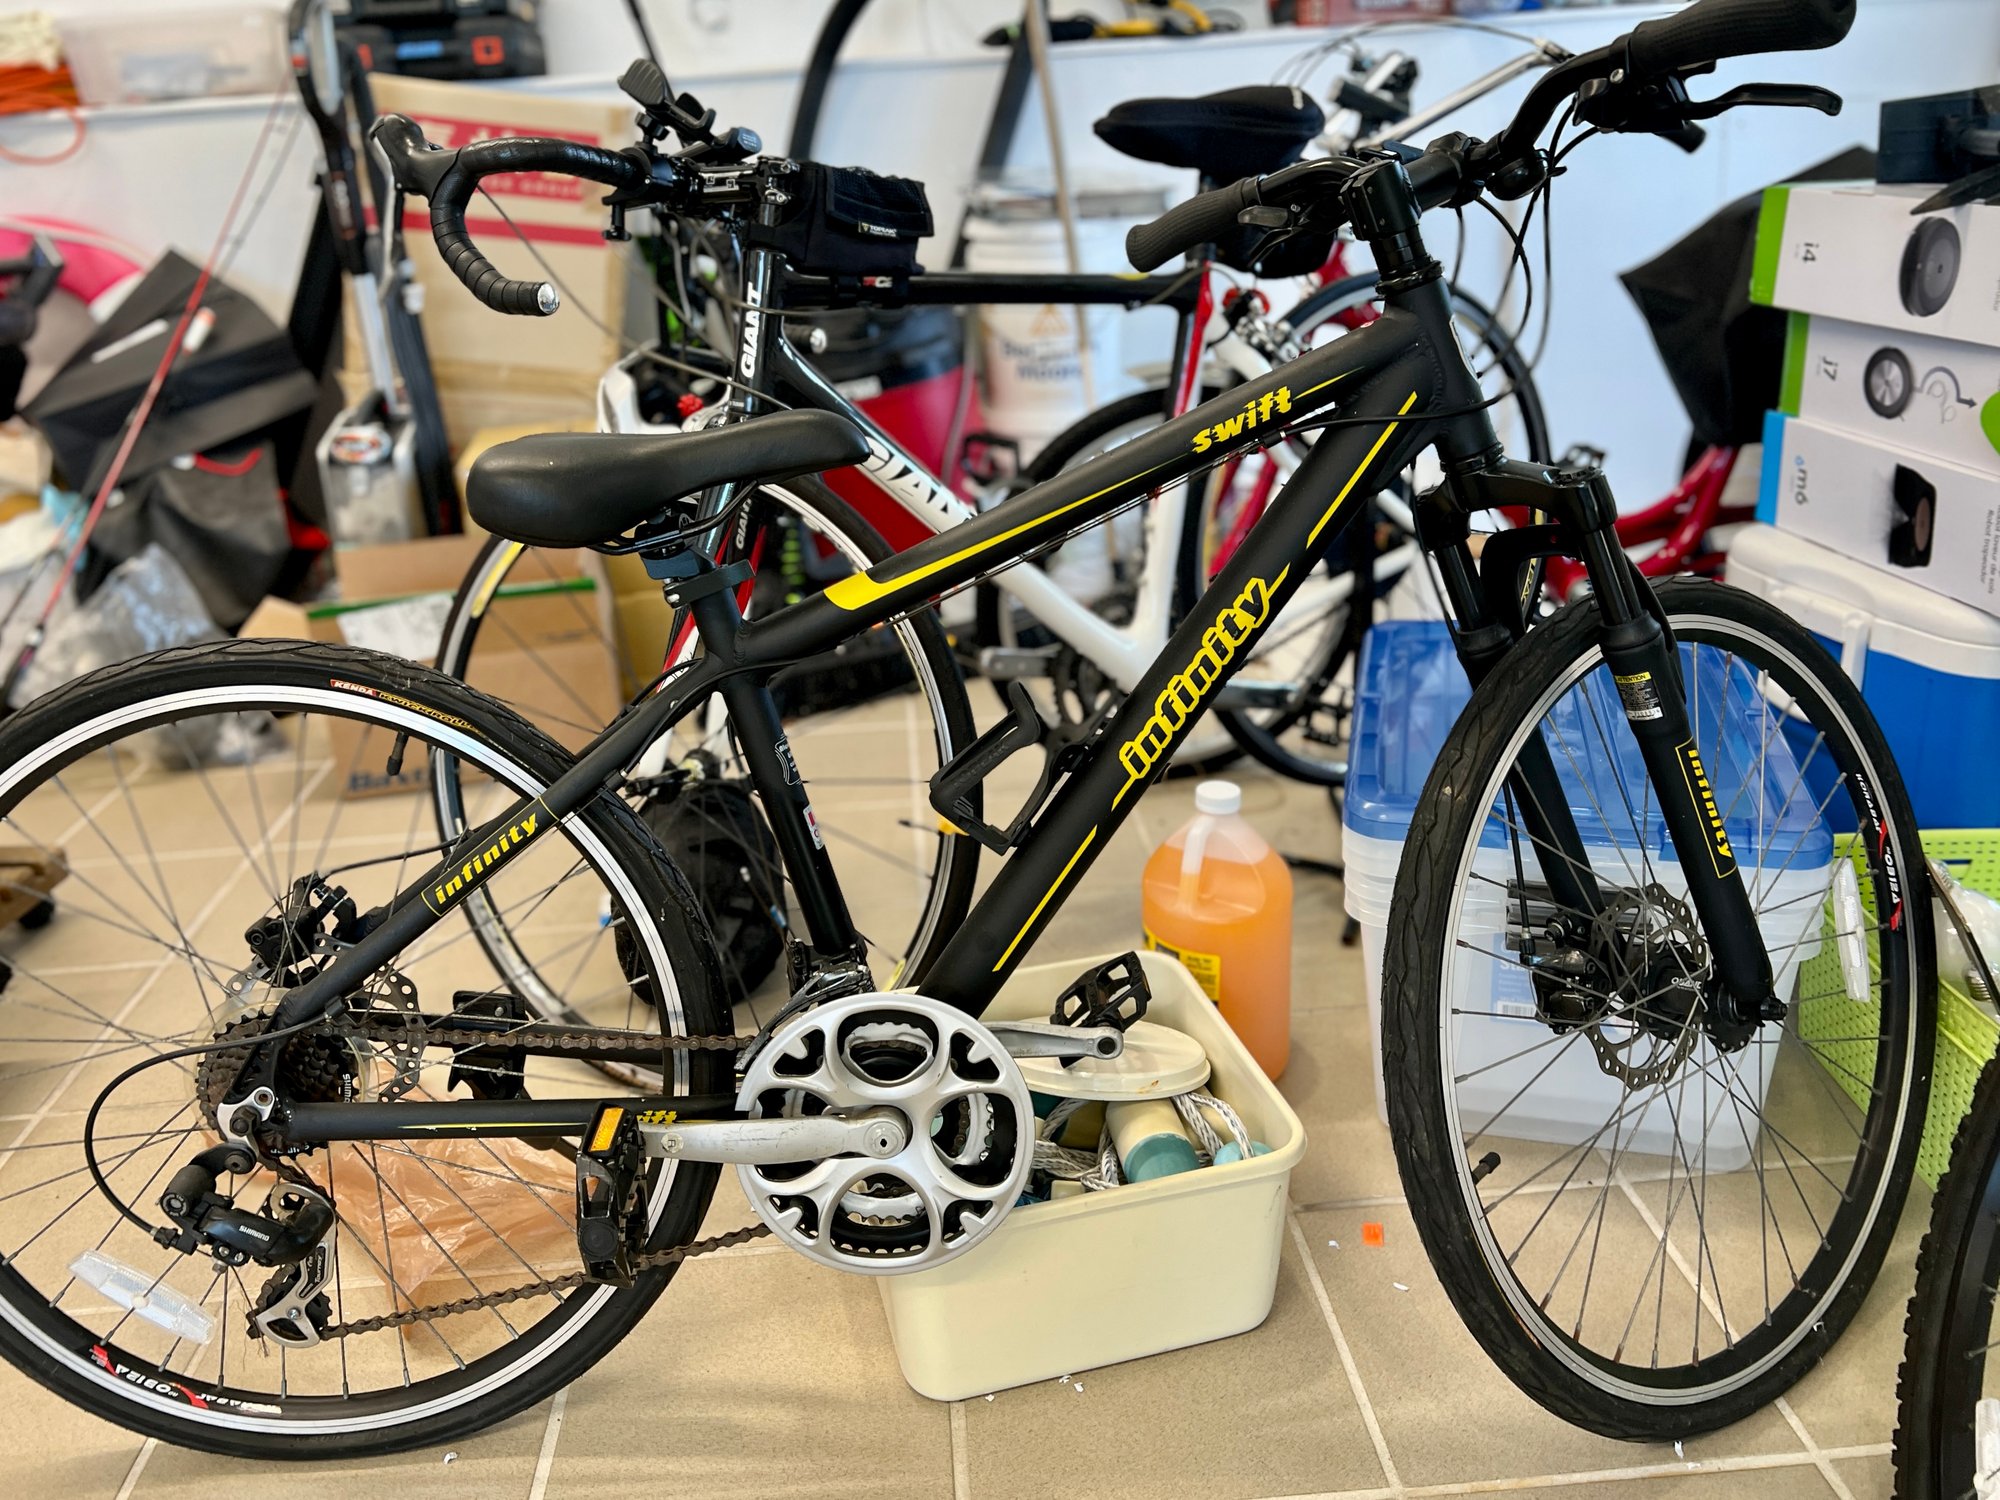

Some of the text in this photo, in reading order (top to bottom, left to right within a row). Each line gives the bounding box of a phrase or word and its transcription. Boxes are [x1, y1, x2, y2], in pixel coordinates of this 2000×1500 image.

[1802, 242, 1819, 264] i4
[740, 281, 763, 378] GIANT
[1822, 356, 1839, 381] j7
[1191, 386, 1292, 454] swift
[333, 680, 375, 697] KENDA
[1119, 577, 1270, 779] infinity
[1687, 749, 1733, 858] infinity
[434, 812, 537, 905] infinity
[637, 1110, 677, 1125] ift
[239, 1225, 270, 1242] SHIMANO
